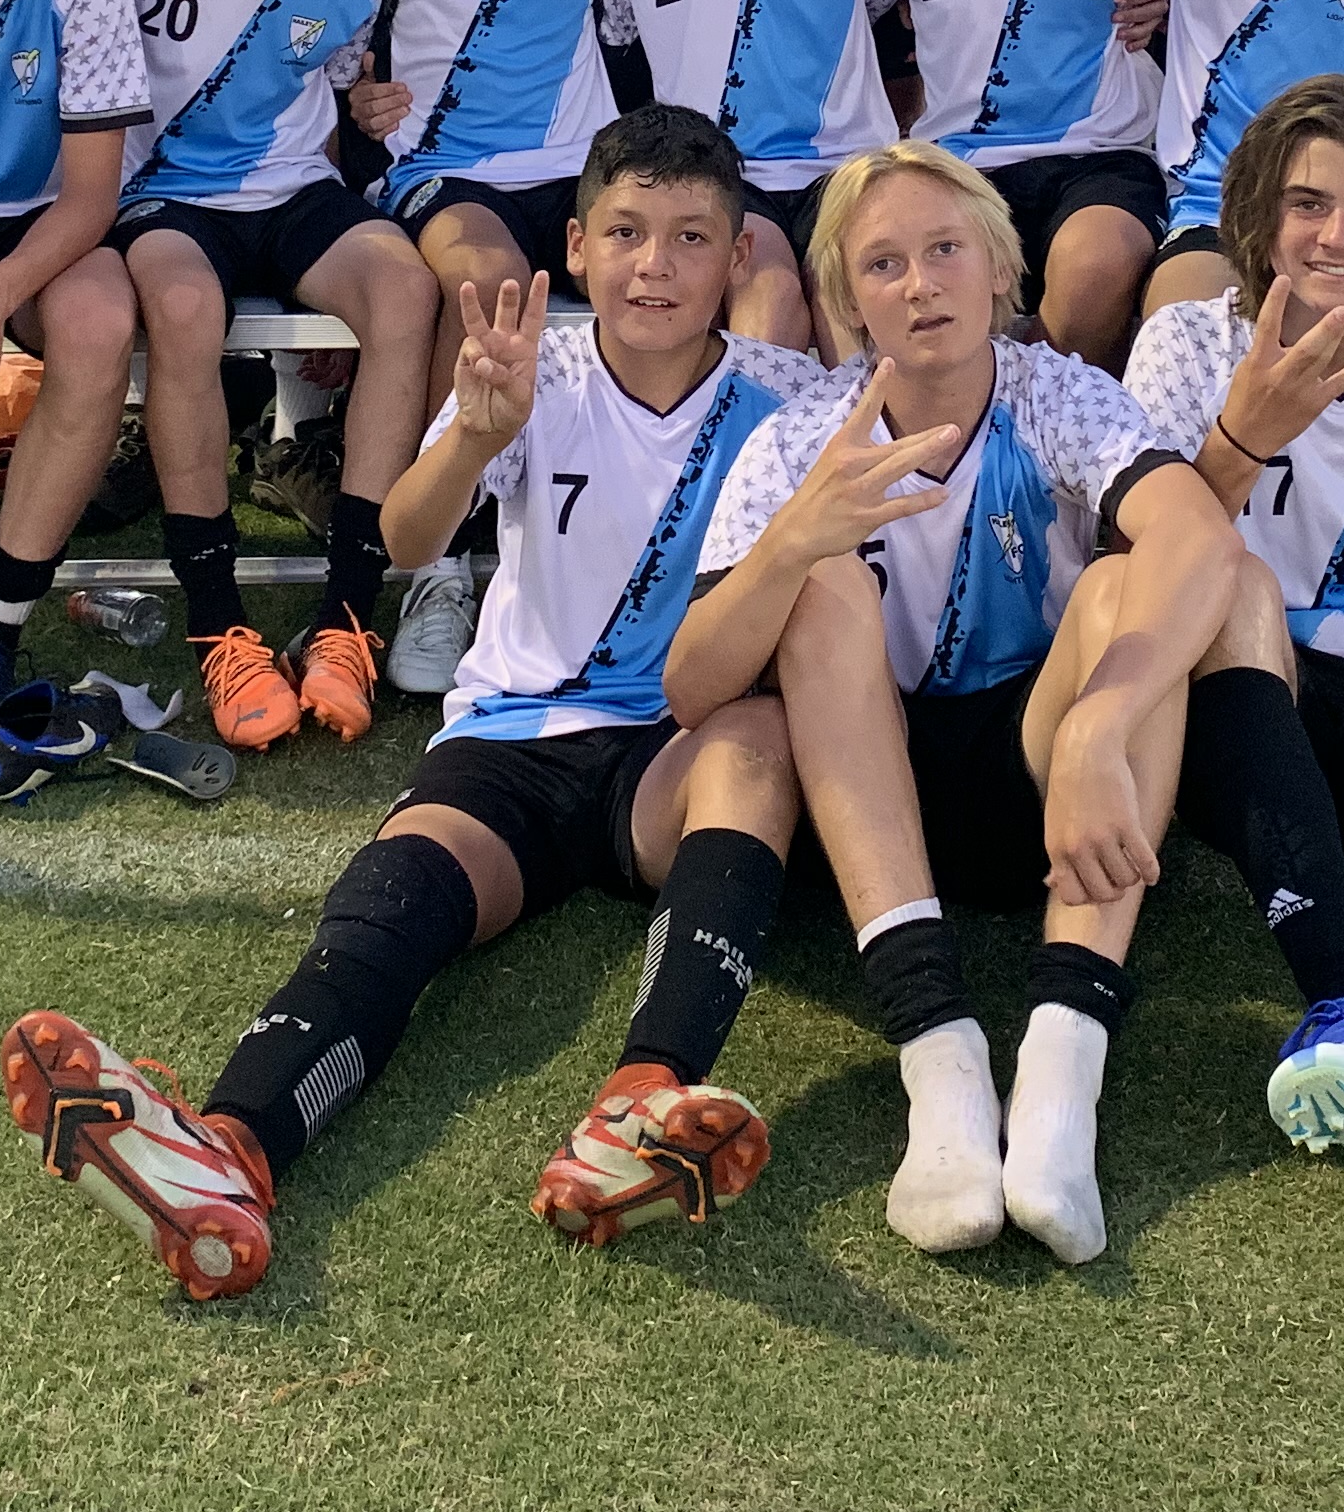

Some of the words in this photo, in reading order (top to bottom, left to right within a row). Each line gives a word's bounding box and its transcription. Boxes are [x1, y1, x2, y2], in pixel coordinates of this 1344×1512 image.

[551, 473, 589, 535] 7
[1266, 898, 1316, 930] adidas
[719, 955, 747, 989] FC
